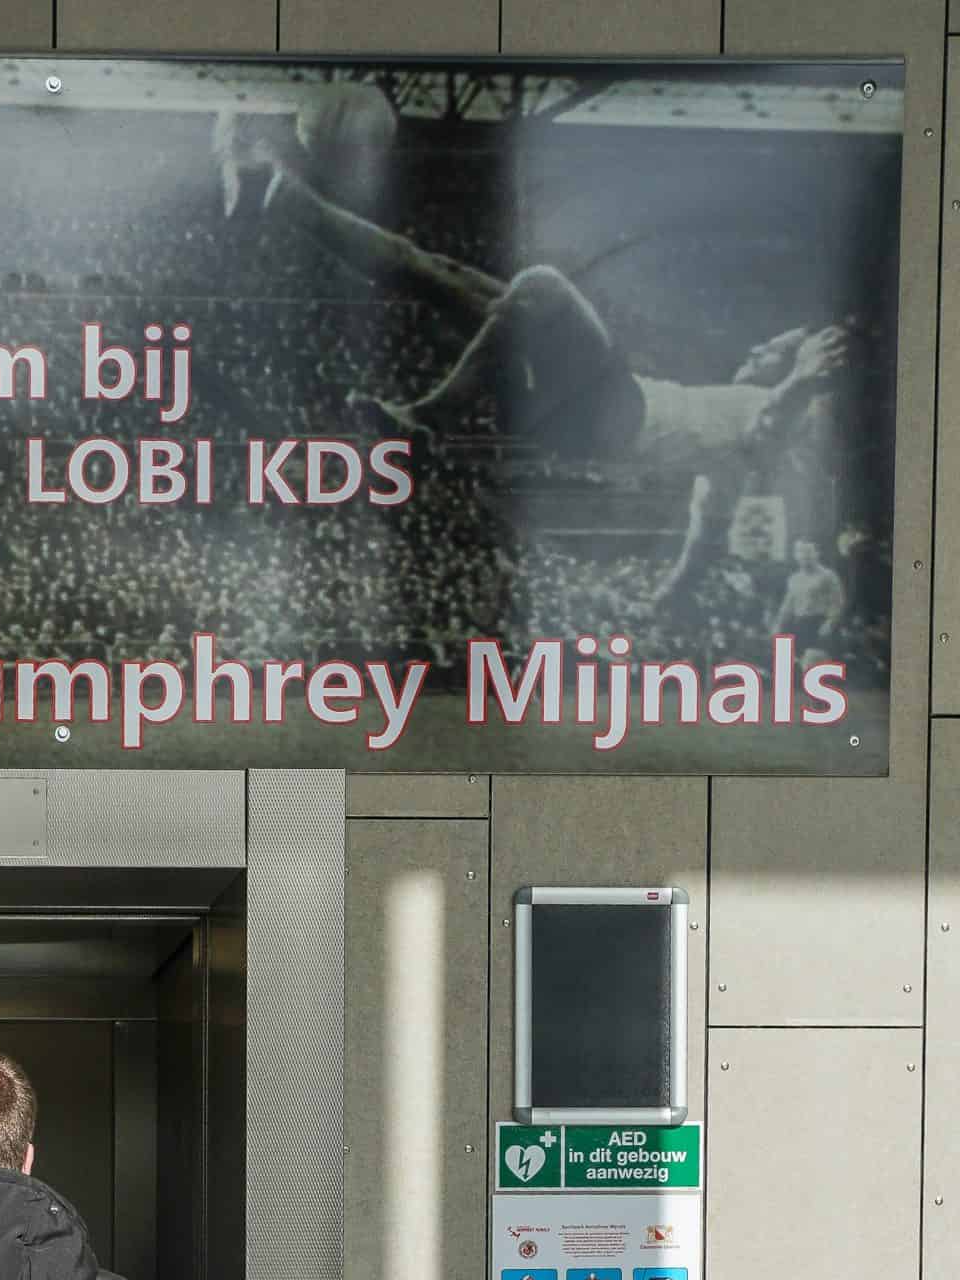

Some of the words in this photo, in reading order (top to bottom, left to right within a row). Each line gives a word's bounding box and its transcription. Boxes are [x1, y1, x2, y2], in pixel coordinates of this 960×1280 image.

[82, 322, 193, 422] bij
[26, 437, 212, 503] LOBI
[247, 438, 414, 505] KDS
[466, 634, 847, 751] Mijnals
[569, 1148, 584, 1163] in
[589, 1148, 613, 1163] dit
[617, 1148, 688, 1165] gebouw
[608, 1131, 647, 1147] AED
[586, 1165, 670, 1182] aanwezig
